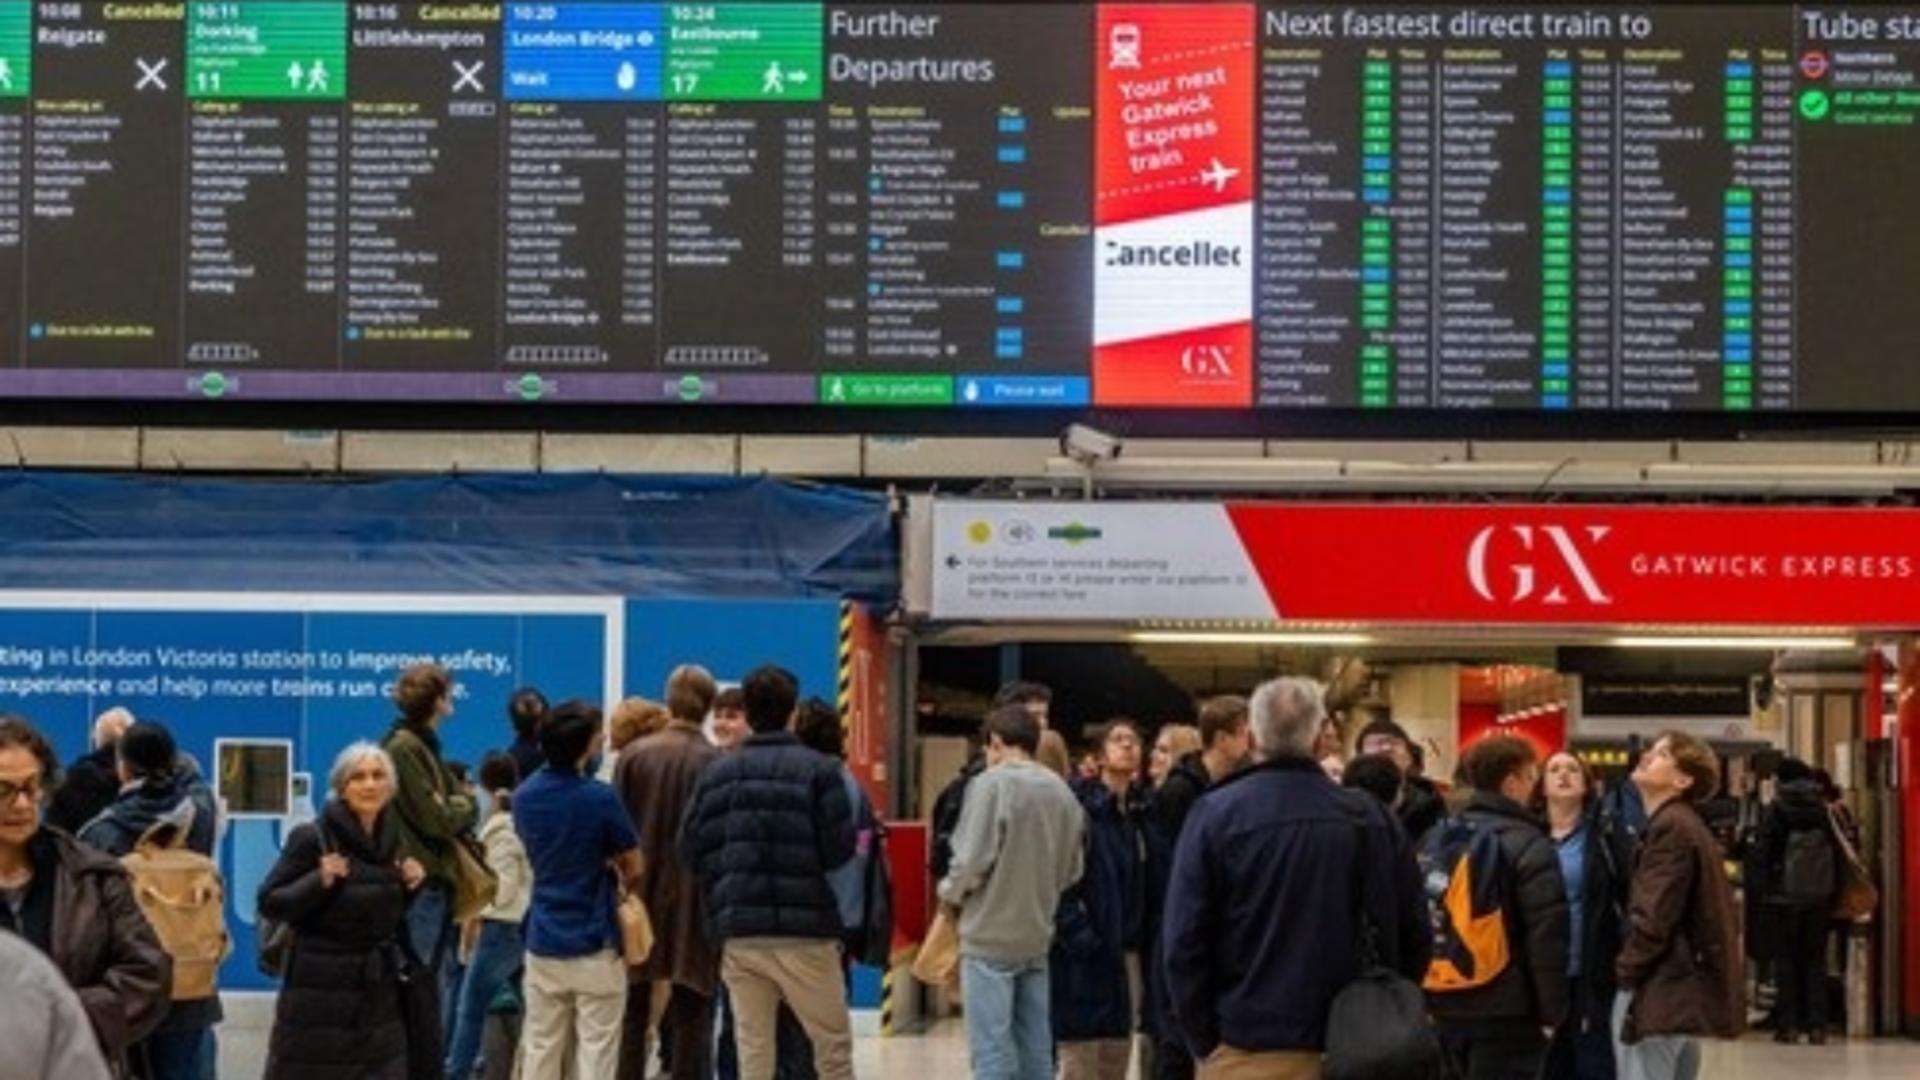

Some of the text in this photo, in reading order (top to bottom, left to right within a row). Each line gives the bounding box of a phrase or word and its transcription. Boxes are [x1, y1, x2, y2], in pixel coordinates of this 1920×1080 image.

[103, 3, 184, 20] Cancelled
[419, 4, 500, 20] Cancelled
[514, 6, 557, 20] 10:20
[1266, 8, 1652, 38] Next fastest direct train to
[195, 23, 258, 43] Dorking
[671, 27, 760, 42] Eastbourne
[831, 10, 940, 38] Further
[1803, 11, 1878, 39] Tube
[38, 28, 105, 47] Reigate
[353, 29, 485, 50] Littlehampton
[512, 30, 634, 51] London Bridge
[196, 71, 220, 92] 11
[511, 71, 548, 86] Wait
[830, 53, 995, 89] Departures
[672, 73, 700, 94] 17
[1119, 66, 1228, 106] Your next
[1122, 93, 1215, 126] Gatwick
[1126, 119, 1218, 151] Express
[1130, 146, 1184, 174] train
[1105, 239, 1242, 267] ancelle
[1181, 344, 1235, 377] GX
[890, 382, 944, 400] platform
[994, 382, 1065, 396] Please wait
[1466, 525, 1613, 604] GX
[1631, 554, 1912, 577] GATWICK EXPRESS
[49, 646, 69, 666] in
[72, 646, 151, 667] London
[156, 649, 236, 668] Victoria
[241, 650, 314, 669] station
[319, 652, 343, 669] to
[348, 651, 435, 674] improve
[440, 650, 512, 676] safety,
[117, 676, 159, 695] and
[162, 676, 209, 700] help
[211, 681, 266, 696] more
[271, 679, 335, 697] trains
[340, 682, 377, 697] run
